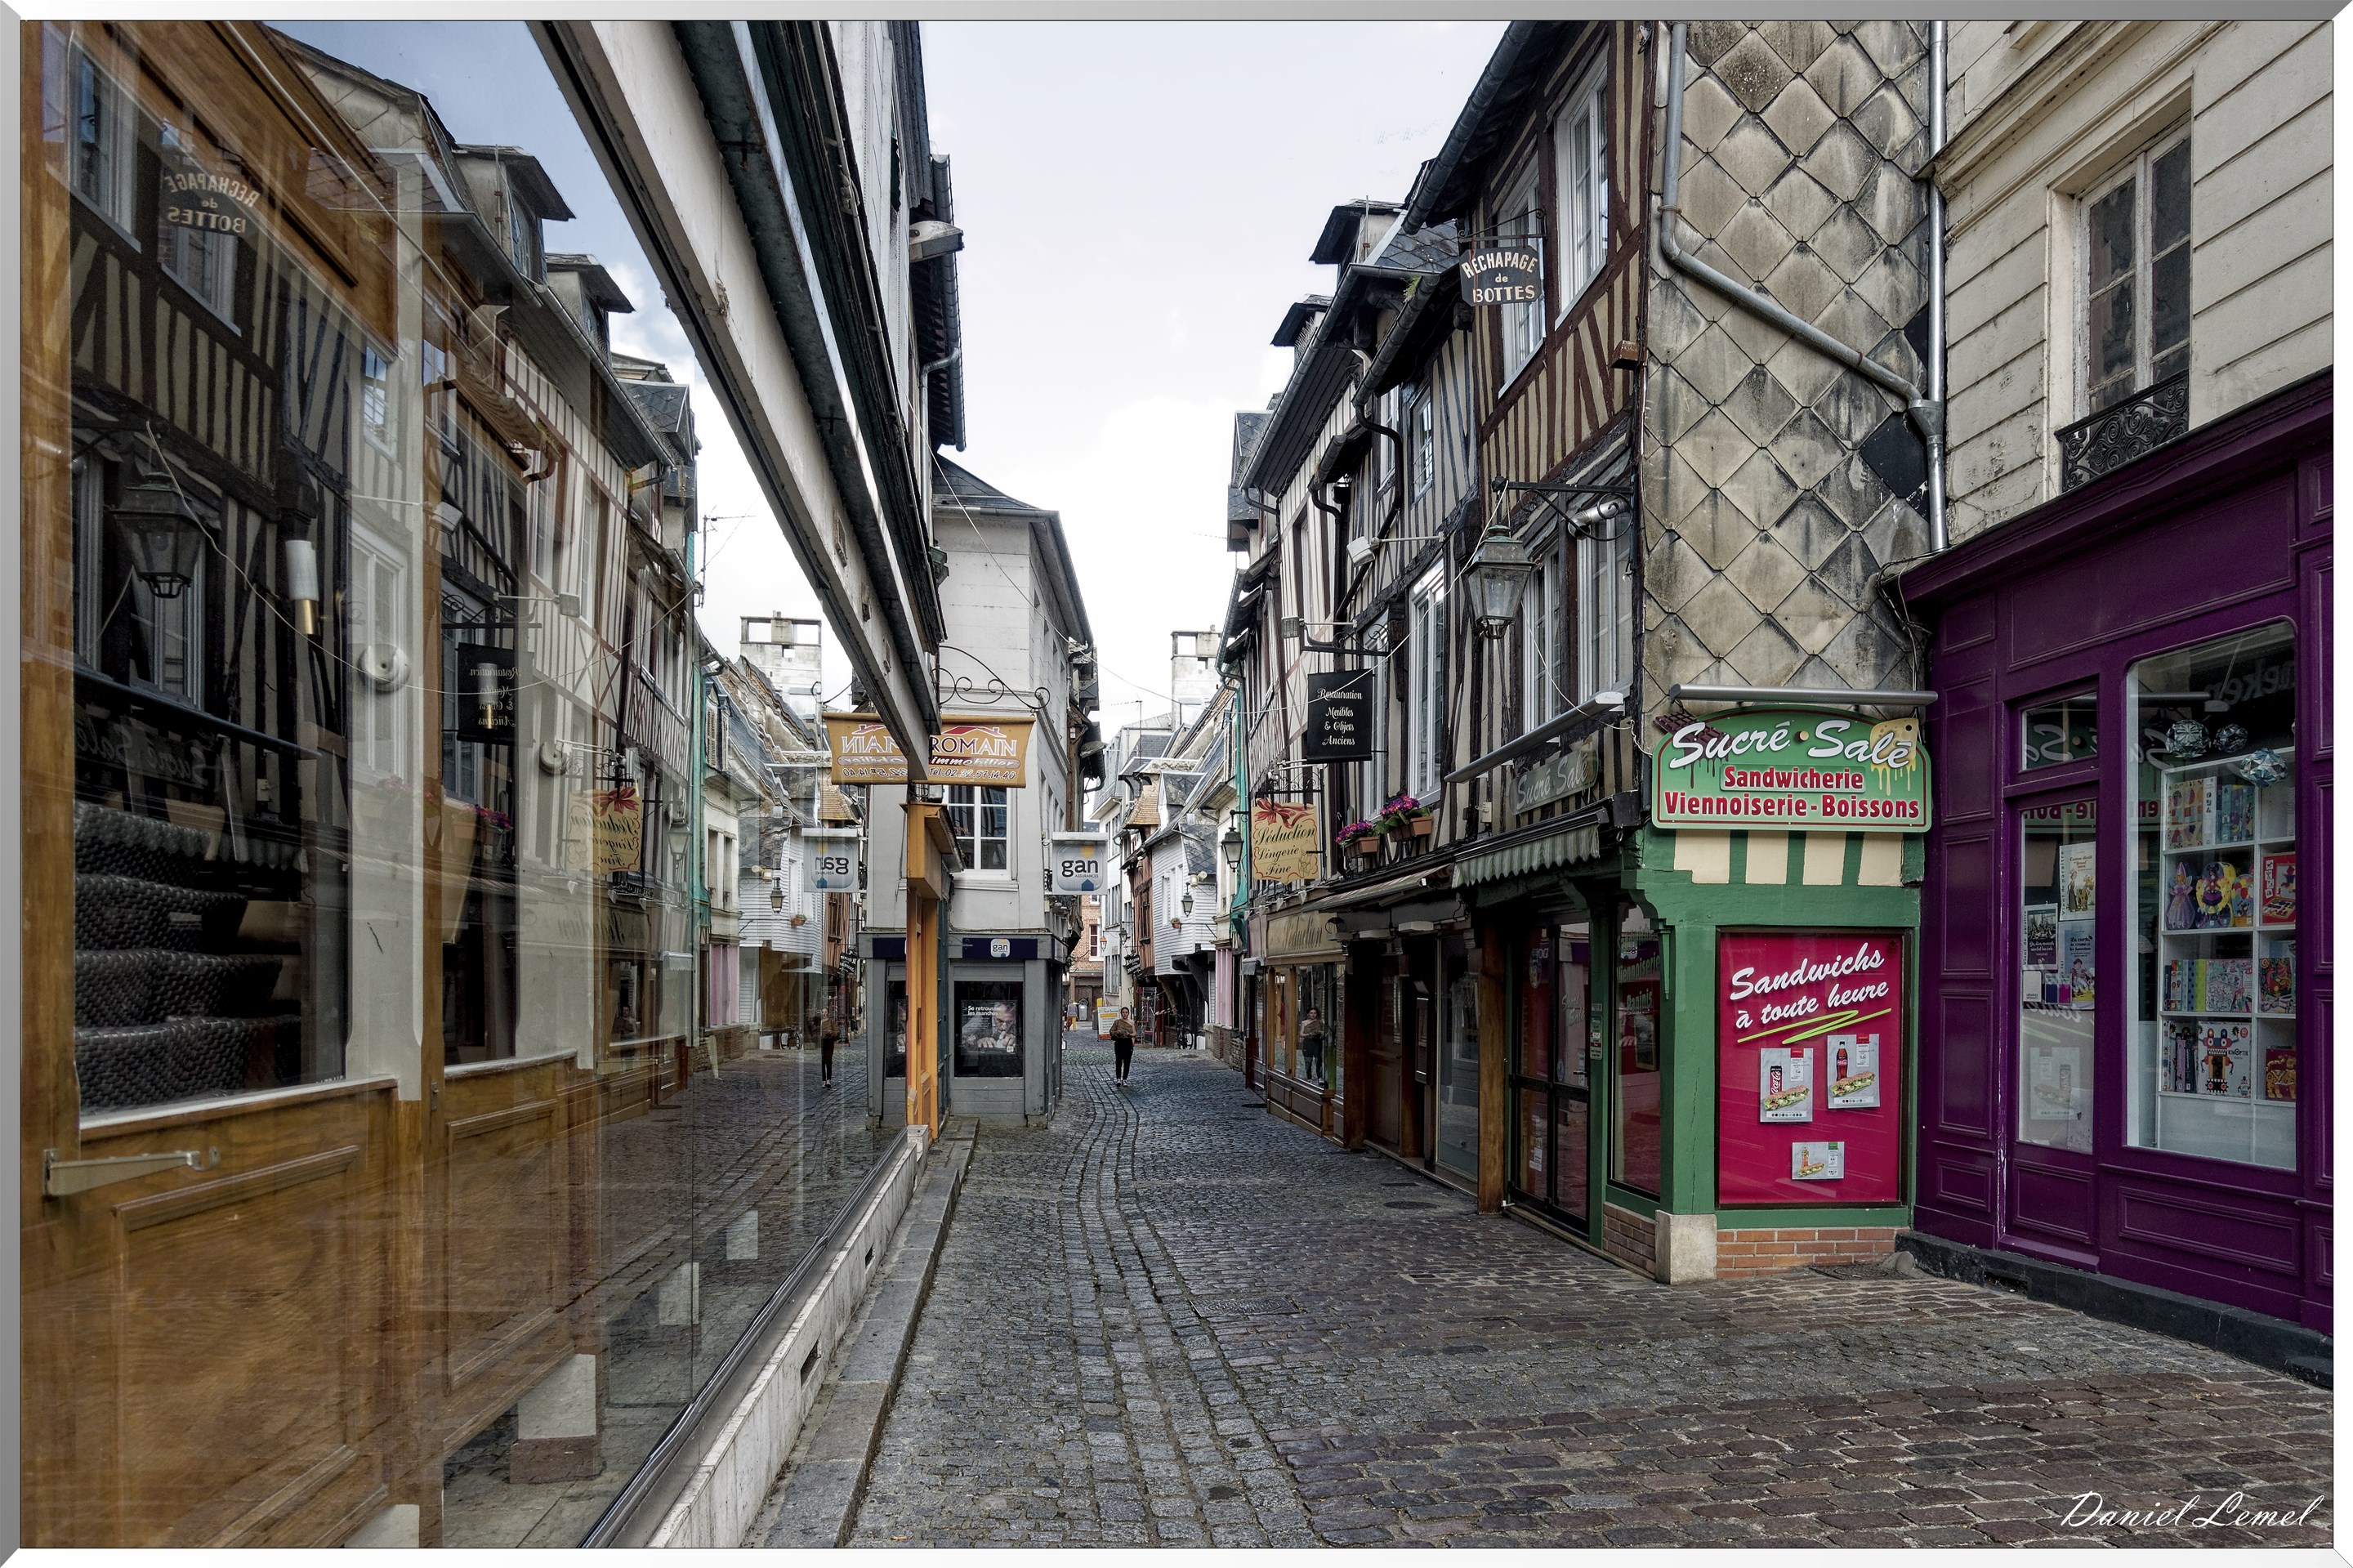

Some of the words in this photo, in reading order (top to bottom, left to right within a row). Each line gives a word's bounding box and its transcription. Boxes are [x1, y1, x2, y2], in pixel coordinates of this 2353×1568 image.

[1494, 272, 1508, 283] de
[1472, 284, 1535, 303] BOTTES
[1316, 687, 1363, 701] Restauration
[1325, 706, 1354, 719] Meubles
[1324, 721, 1332, 730] &
[1333, 720, 1355, 734] Objets
[930, 735, 1018, 757] ROMAIN
[1322, 735, 1355, 745] Anciens
[1669, 720, 1792, 769] Sucré
[1807, 719, 1913, 769] Salé
[931, 756, 1015, 766] immobilier
[1516, 768, 1552, 811] Sucré
[1556, 751, 1589, 796] Salé
[1724, 766, 1864, 790] Sandwicherie
[1664, 791, 1807, 816] Viennoiserie
[1821, 794, 1920, 819] Boissons
[1255, 824, 1316, 847] Séduction
[1257, 846, 1300, 862] Lingerie
[1061, 860, 1099, 878] gan
[1266, 863, 1292, 876] Fine
[993, 944, 1008, 952] gan
[1730, 942, 1885, 1001] Sandwichs
[1735, 1010, 1753, 1029] à
[1760, 995, 1819, 1025] toute
[1827, 981, 1889, 1008] heure
